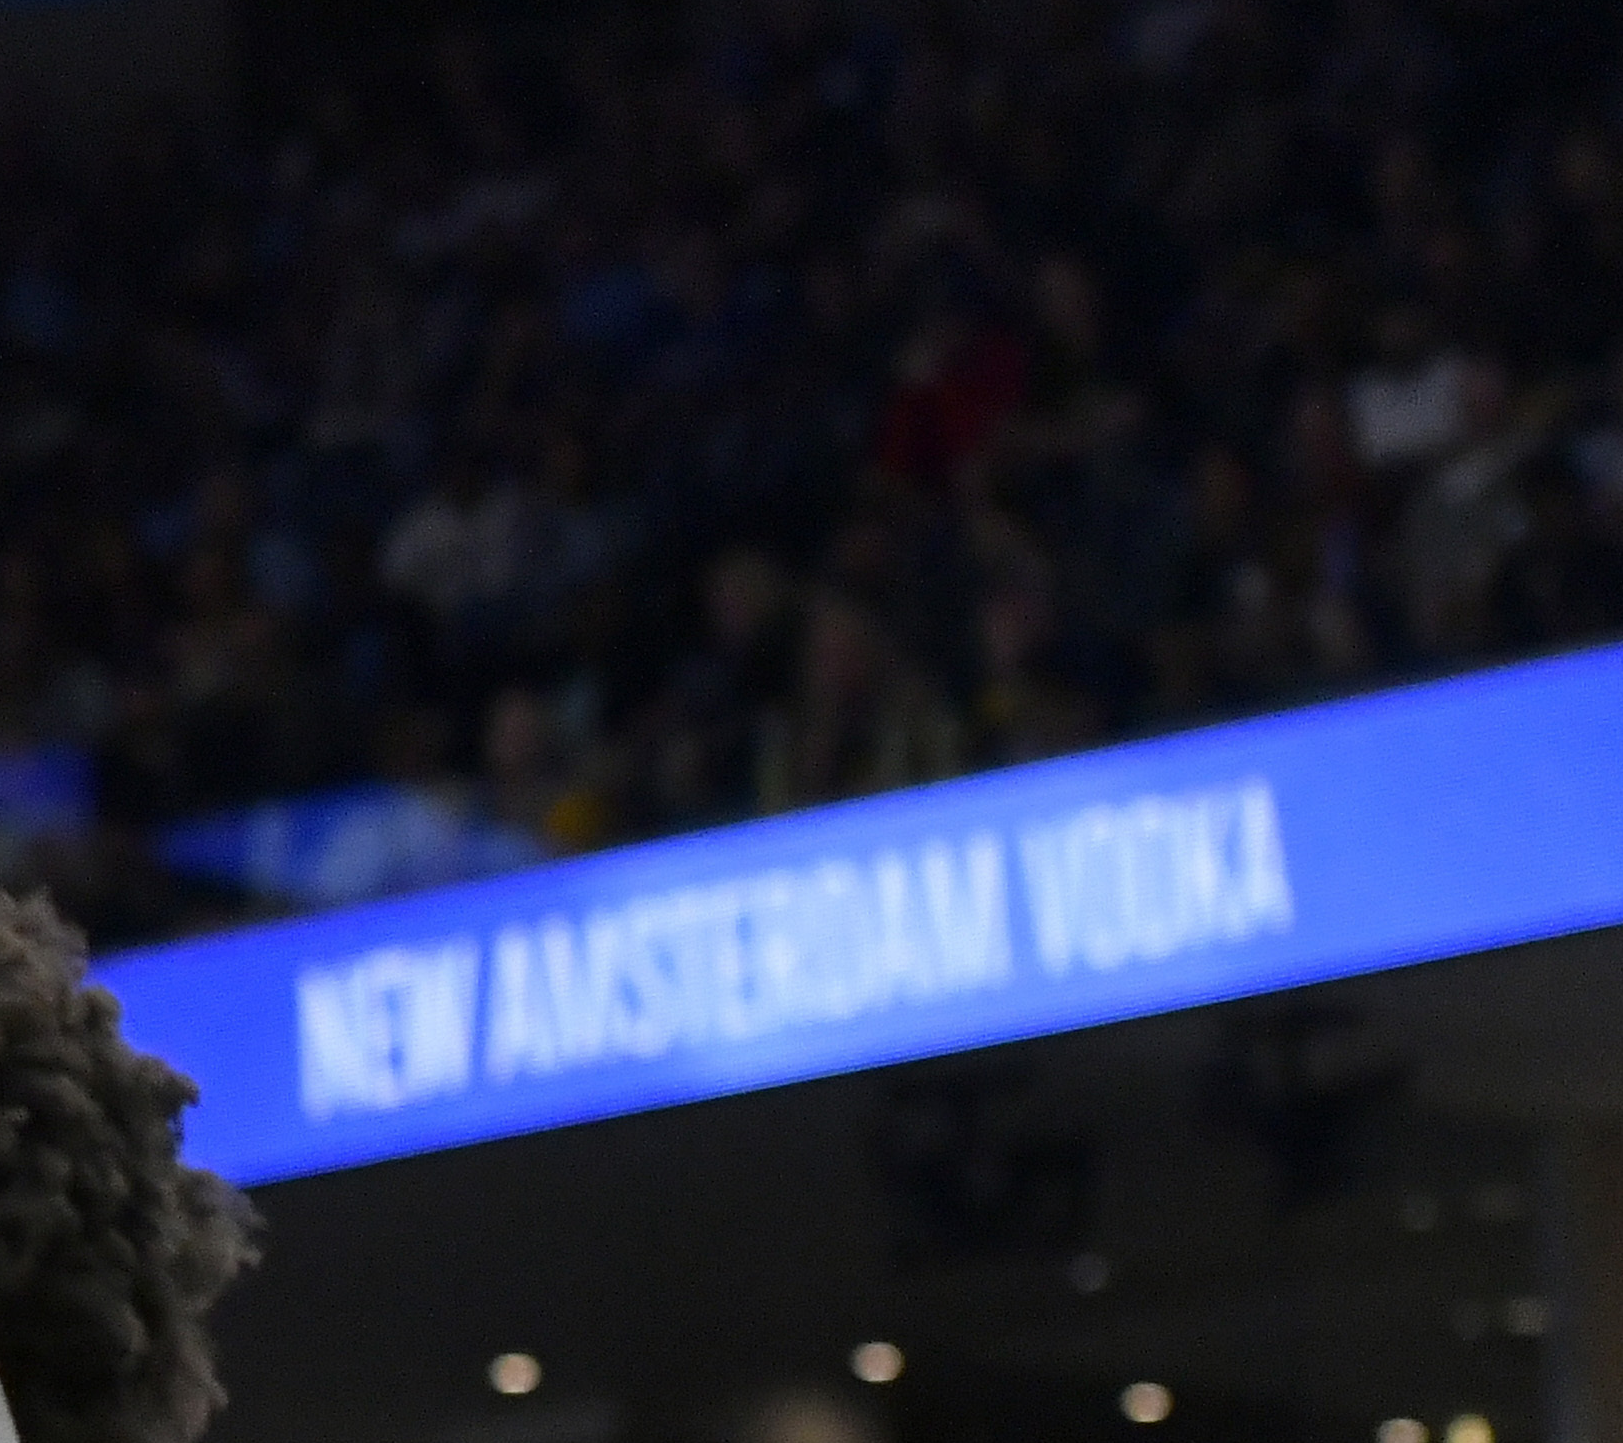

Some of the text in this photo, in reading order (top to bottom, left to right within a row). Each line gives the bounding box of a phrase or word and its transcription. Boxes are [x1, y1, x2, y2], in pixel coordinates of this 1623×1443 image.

[297, 779, 1293, 1122] NEW AMSTERDAM VODKA
